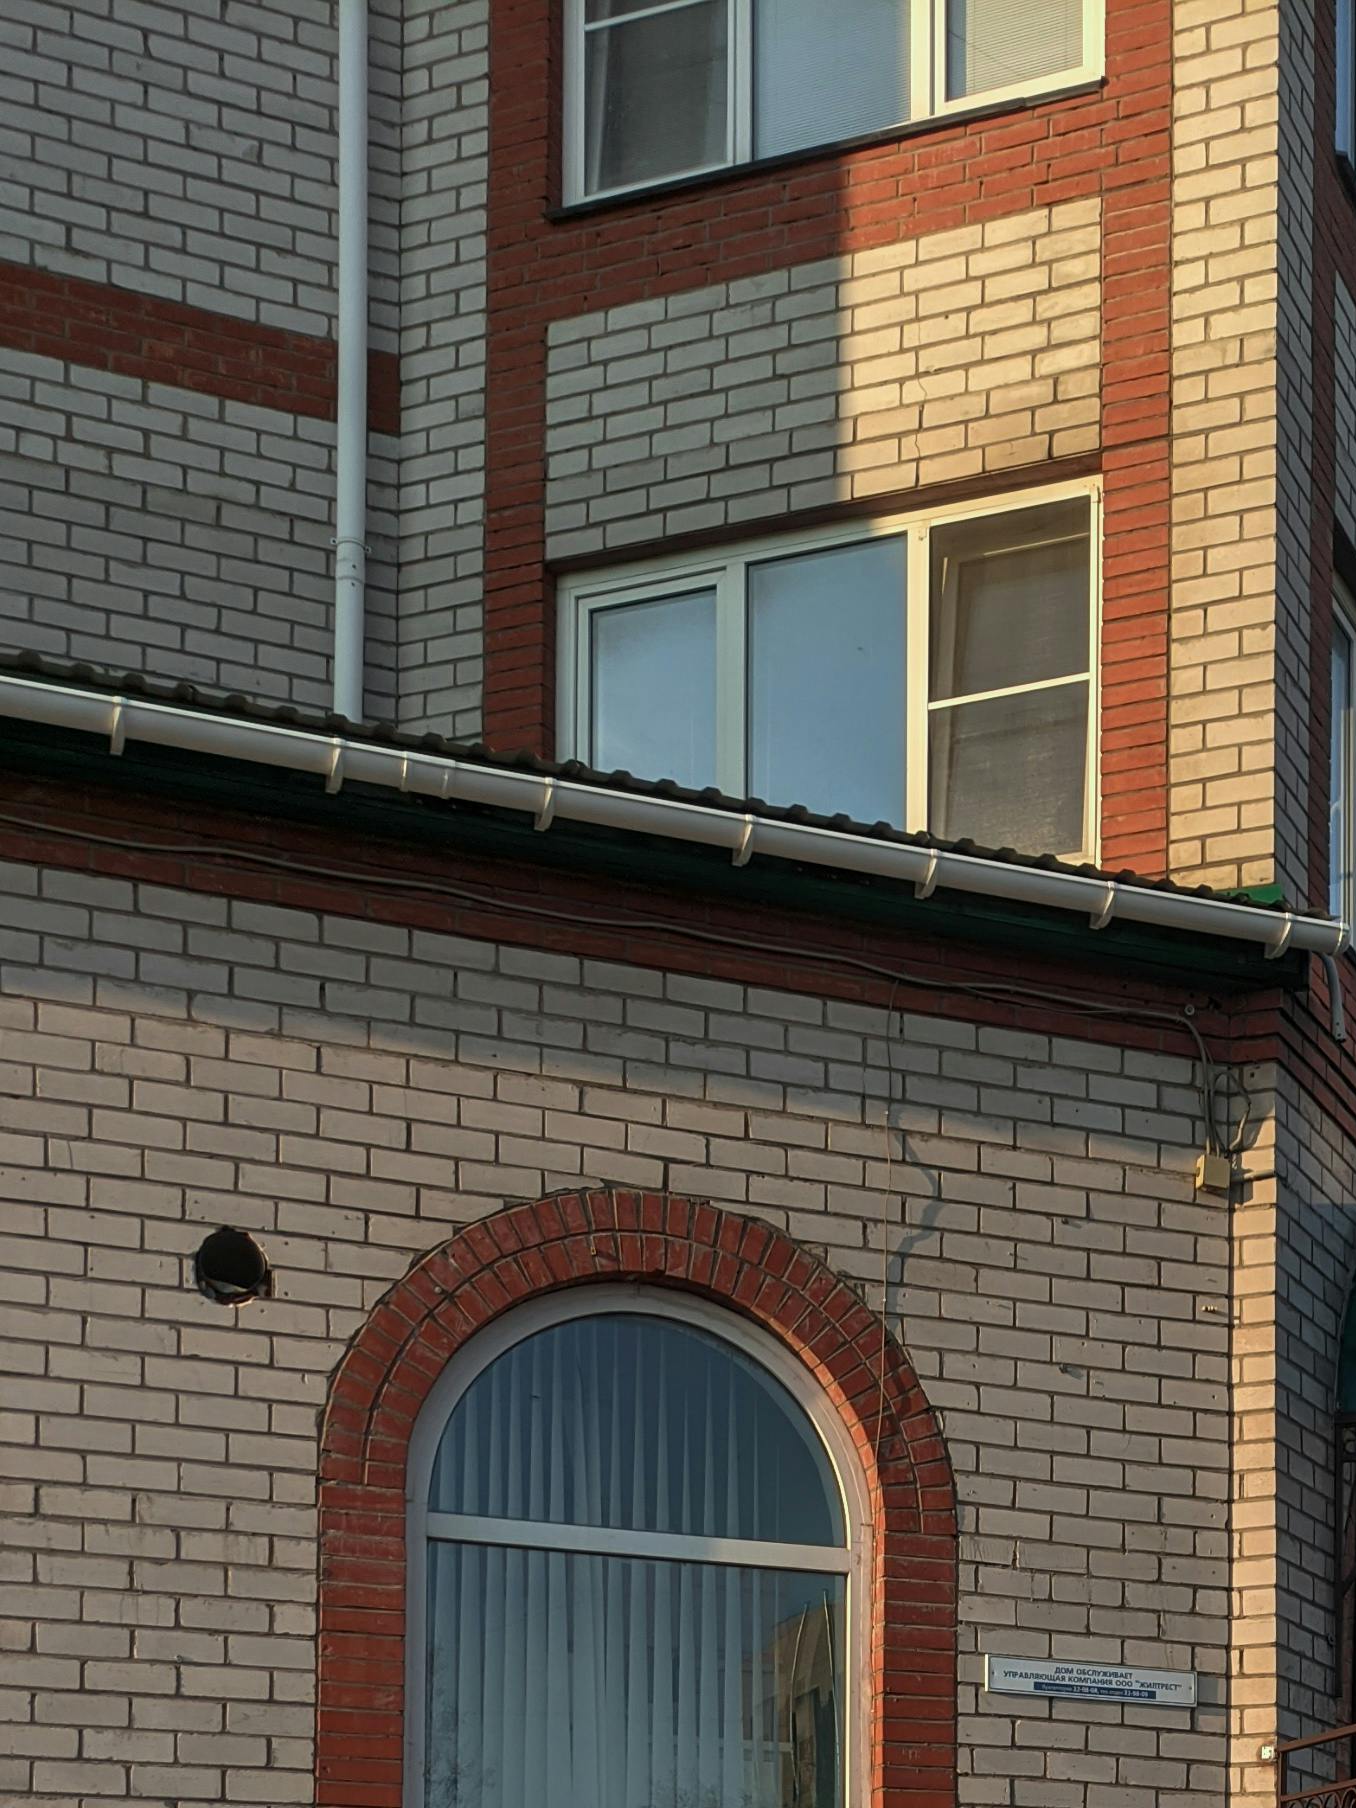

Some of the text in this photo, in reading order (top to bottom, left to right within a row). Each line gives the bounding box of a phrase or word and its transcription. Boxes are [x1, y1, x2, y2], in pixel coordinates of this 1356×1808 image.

[1003, 1670, 1066, 1682] УПРАВЛЯЮЩАЯ
[1068, 1676, 1113, 1686] КОМПАНИЯ
[1055, 1667, 1133, 1679] ДОМ ОБСЛУЖИВАЕТ
